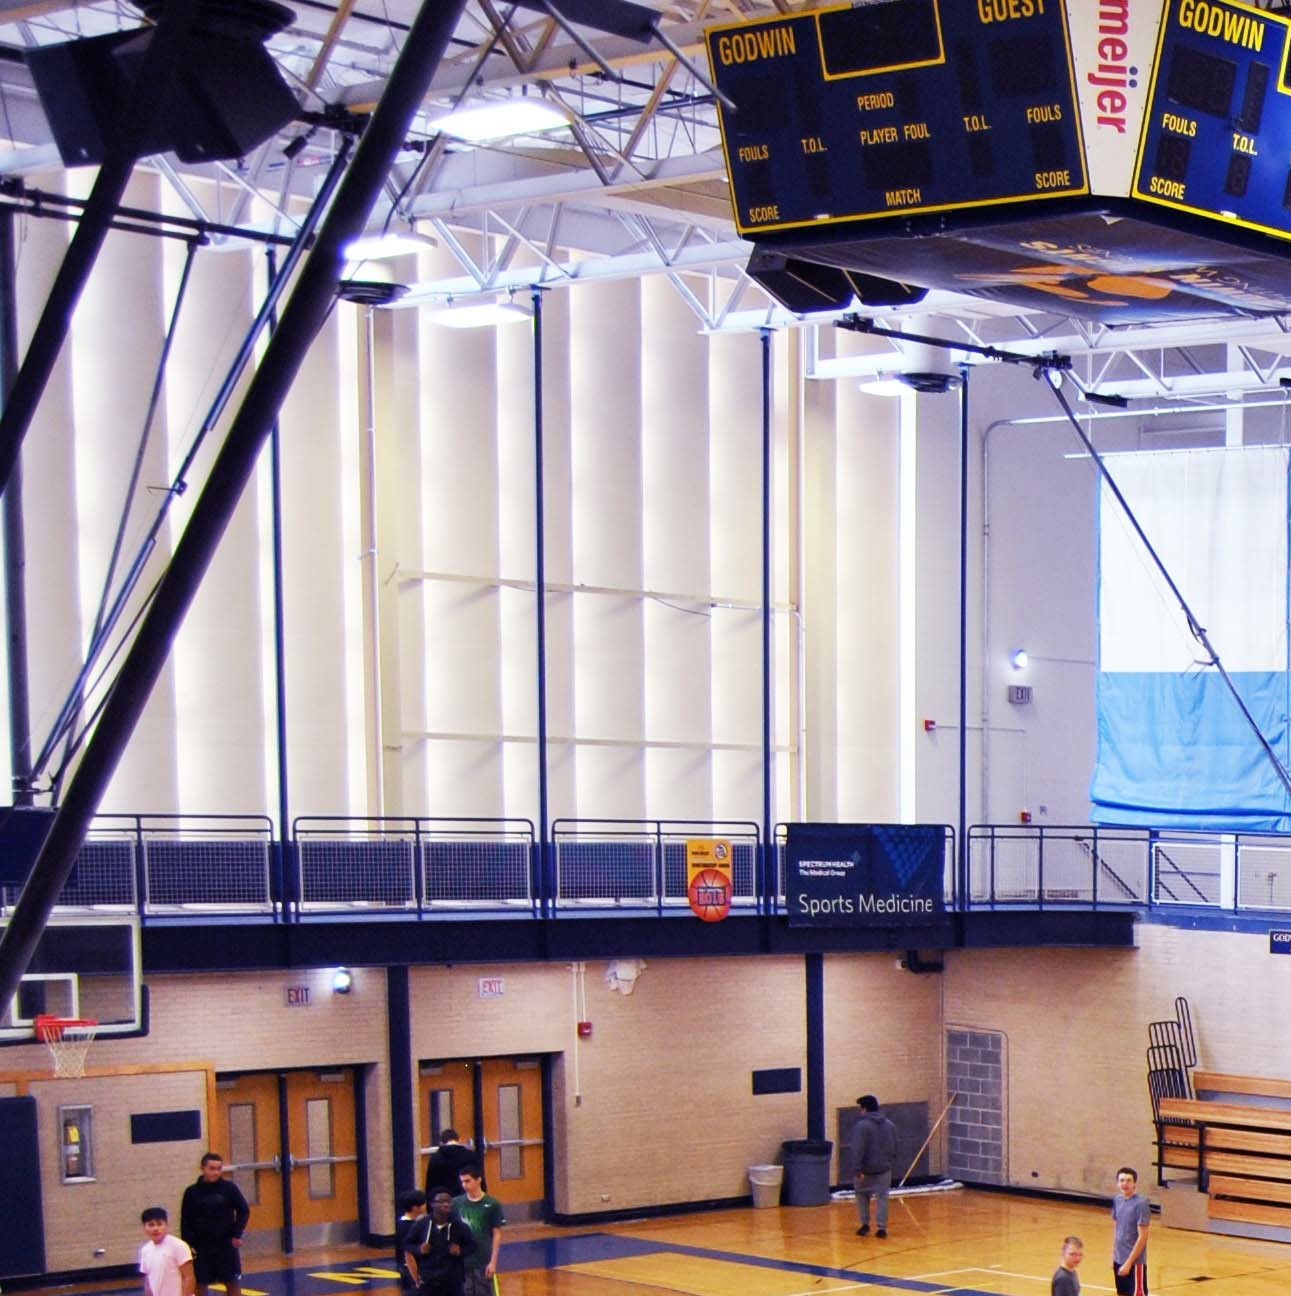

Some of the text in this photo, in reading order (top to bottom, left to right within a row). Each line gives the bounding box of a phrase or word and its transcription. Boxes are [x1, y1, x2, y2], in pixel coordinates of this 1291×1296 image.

[1178, 0, 1265, 53] GODWIN
[719, 27, 796, 65] GODWIN
[1087, 0, 1138, 134] meijer
[857, 92, 894, 111] PERIOD
[1026, 105, 1062, 124] FOULS
[860, 123, 931, 145] PLAYER FOUL
[1162, 112, 1198, 137] FOULS
[739, 144, 769, 162] FOULS
[1035, 171, 1071, 189] SCORE
[1149, 176, 1185, 200] SCORE
[885, 189, 921, 207] MATCH
[749, 205, 780, 223] SCORE
[799, 894, 933, 917] Sports Medicine
[287, 988, 310, 1004] EXIT
[482, 979, 504, 995] EXIT
